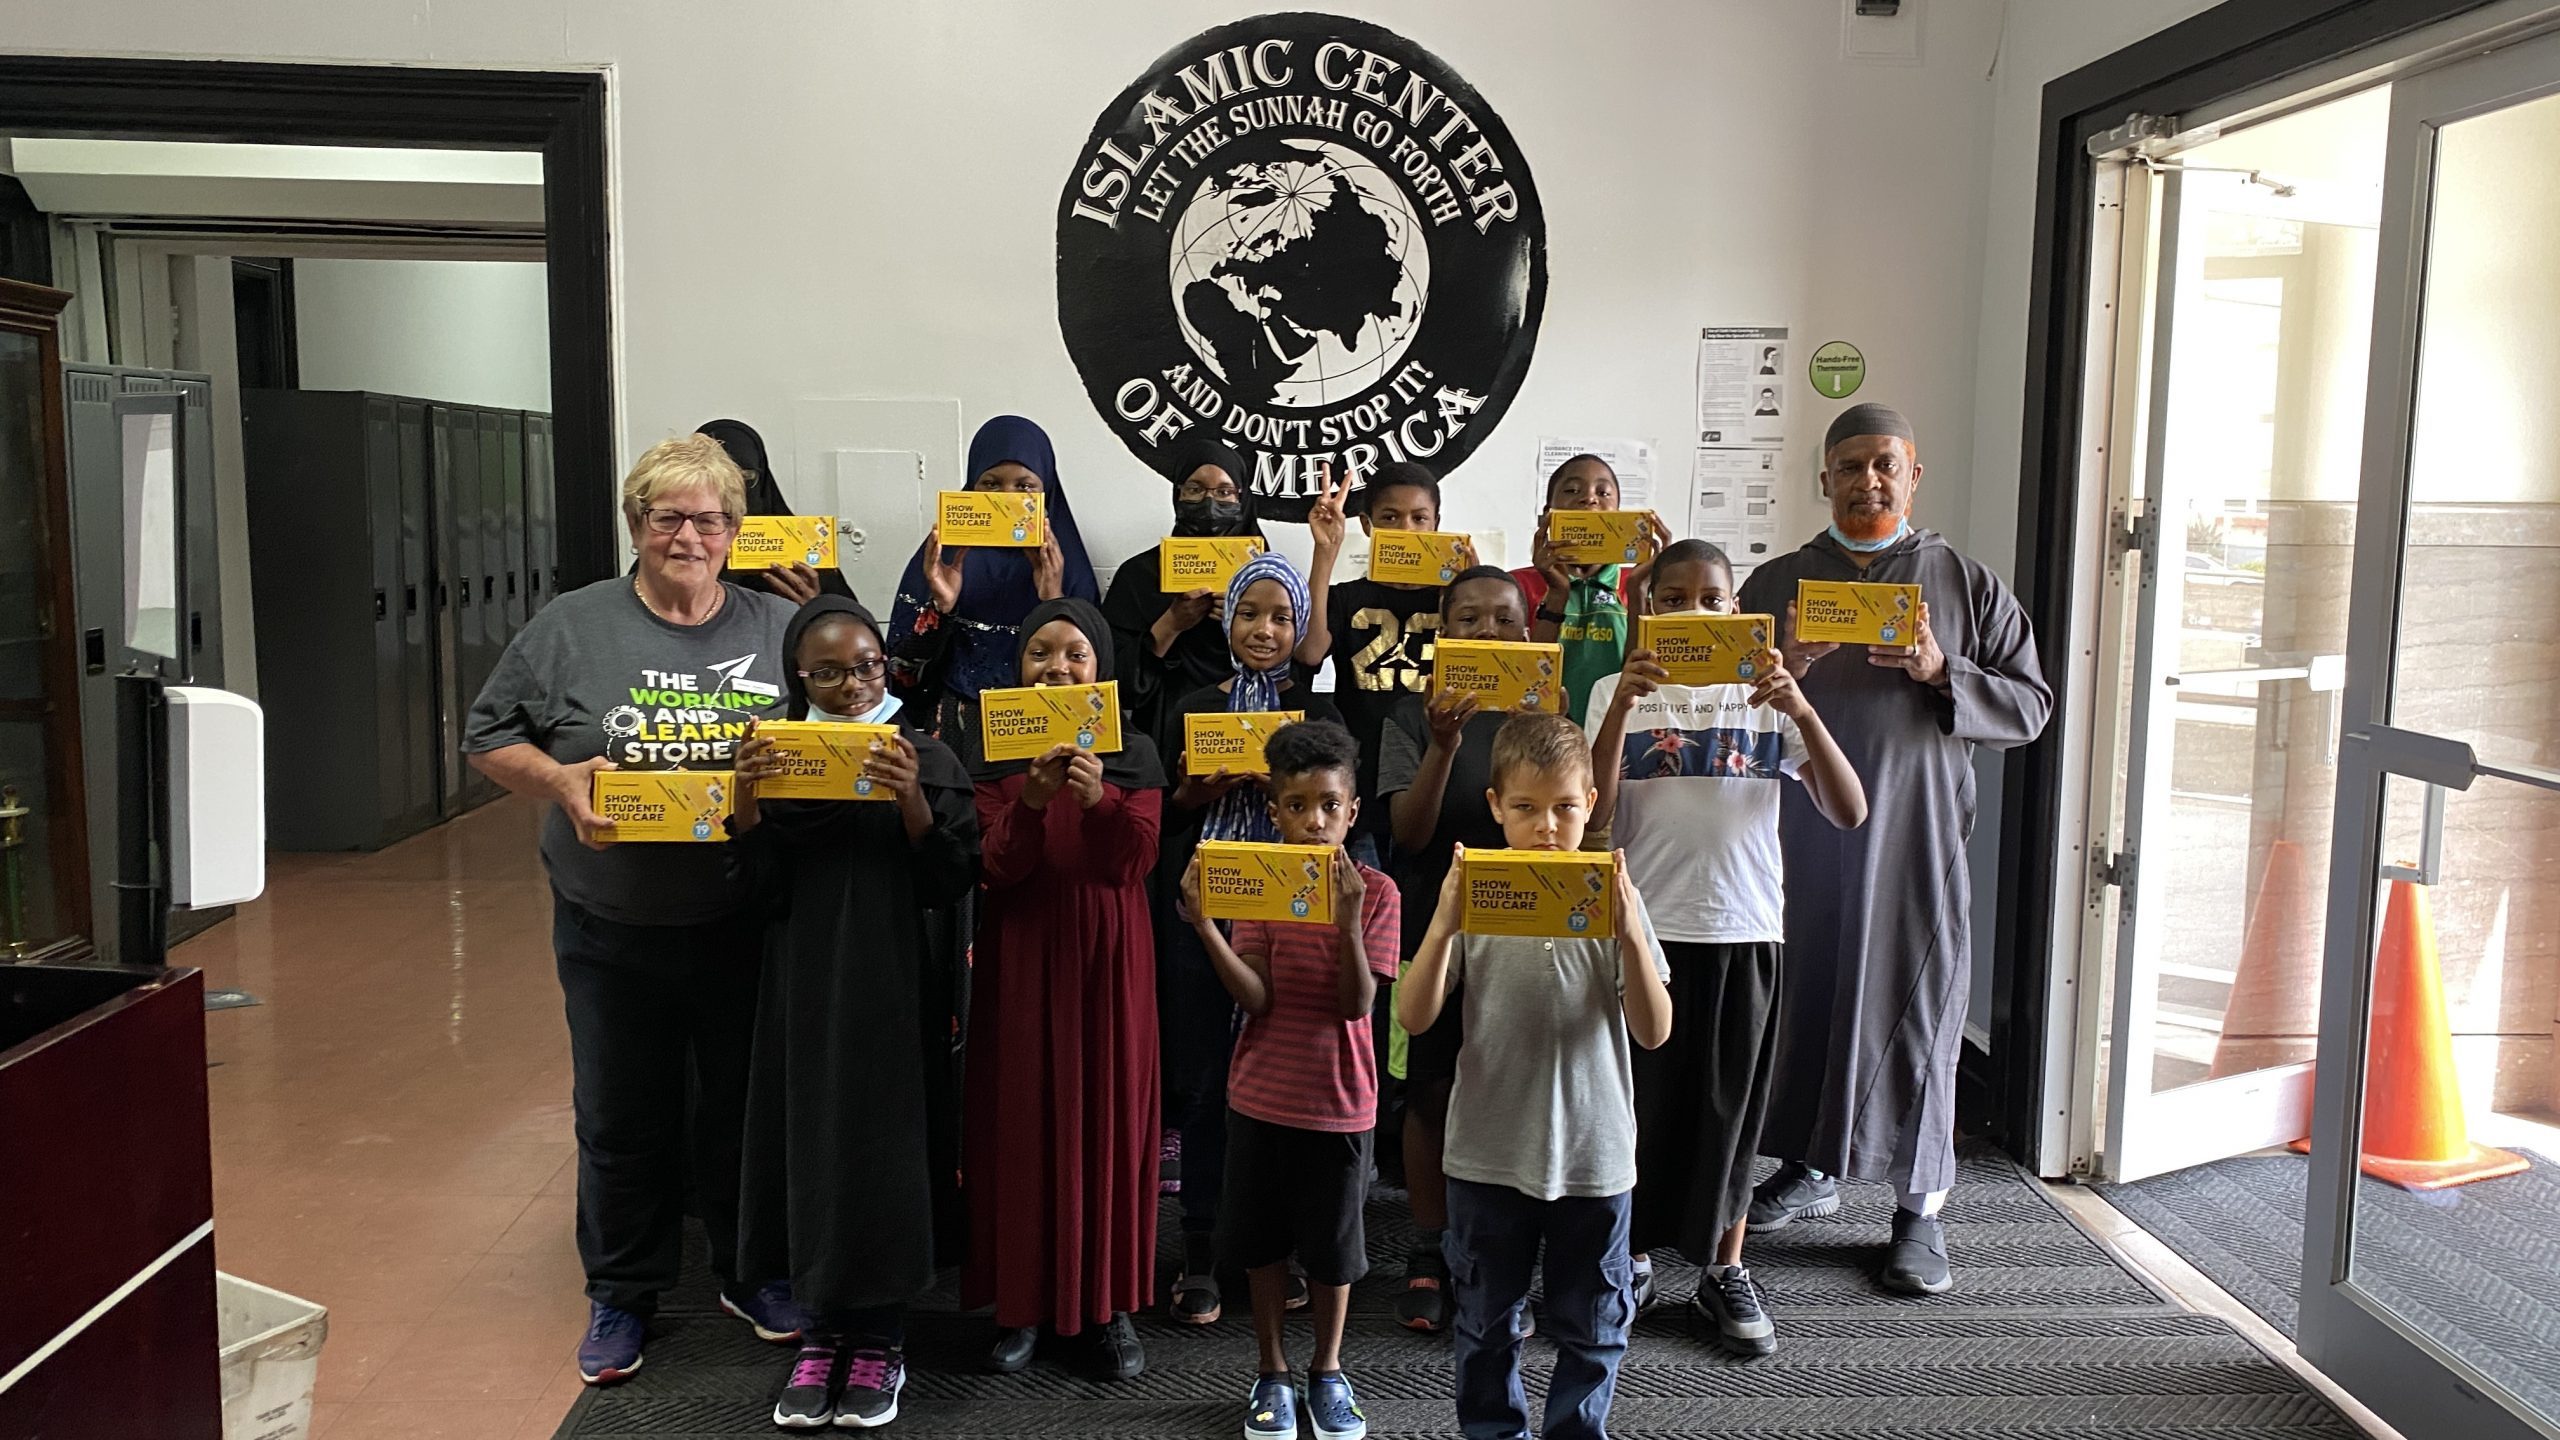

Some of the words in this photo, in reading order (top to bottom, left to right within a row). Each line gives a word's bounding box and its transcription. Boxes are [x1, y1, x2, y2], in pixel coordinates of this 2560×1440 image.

[1071, 39, 1294, 229] ISLAMIC
[1314, 41, 1520, 235] CENTER
[1134, 164, 1181, 223] LET
[1173, 116, 1231, 168] THE
[1229, 95, 1348, 136] SUNNAH
[1353, 109, 1395, 149] GO
[1389, 134, 1462, 227] FORTH
[1816, 355, 1860, 363] Hands-Free
[1161, 362, 1225, 419] AND
[1221, 406, 1312, 449] DON'T
[1318, 393, 1393, 447] STOP
[1399, 360, 1435, 407] IT!
[1115, 377, 1195, 449] OF
[1222, 385, 1489, 499] MERICA
[946, 504, 973, 512] SHOW
[946, 511, 992, 519] STUDENTS
[967, 519, 991, 527] CARE
[1379, 551, 1422, 560] STUDENTS
[1398, 558, 1420, 566] CARE
[1807, 599, 1839, 607] SHOW
[1806, 607, 1858, 616] STUDENTS
[1806, 615, 1828, 623] YOU
[1829, 616, 1857, 625] CARE
[1586, 621, 1613, 641] Faso
[1656, 637, 1690, 645] SHOW
[1656, 645, 1713, 654] STUDENTS
[1657, 654, 1679, 663] YOU
[1681, 654, 1711, 662] CARE
[1445, 664, 1479, 673] SHOW
[641, 669, 699, 691] THE
[1445, 672, 1500, 683] STUDENTS
[1469, 682, 1498, 691] CARE
[629, 687, 775, 709] WORKING
[1638, 702, 1688, 714] POSITIVE
[1694, 703, 1714, 713] AND
[1719, 701, 1749, 713] HAPPY
[653, 707, 719, 724] AND
[989, 708, 1024, 719] SHOW
[989, 716, 1049, 728] STUDENTS
[990, 727, 1015, 737] YOU
[1017, 725, 1048, 735] CARE
[1194, 730, 1225, 739] SHOW
[1078, 733, 1093, 744] 19
[1194, 738, 1246, 747] STUDENTS
[624, 741, 732, 763] STORE
[1194, 746, 1216, 755] YOU
[1218, 746, 1245, 754] CARE
[794, 767, 826, 777] CARE
[857, 780, 871, 791] 19
[604, 794, 641, 803] SHOW
[604, 803, 666, 812] STUDENTS
[632, 813, 665, 821] CARE
[695, 825, 710, 836] 19
[1207, 866, 1242, 876] SHOW
[1207, 876, 1265, 888] STUDENTS
[1471, 879, 1512, 890] SHOW
[1208, 885, 1232, 895] YOU
[1233, 886, 1264, 897] CARE
[1471, 889, 1538, 900] STUDENTS
[1293, 901, 1306, 912] 19
[1472, 899, 1499, 909] YOU
[1501, 900, 1537, 911] CARE
[1571, 916, 1587, 927] 19
